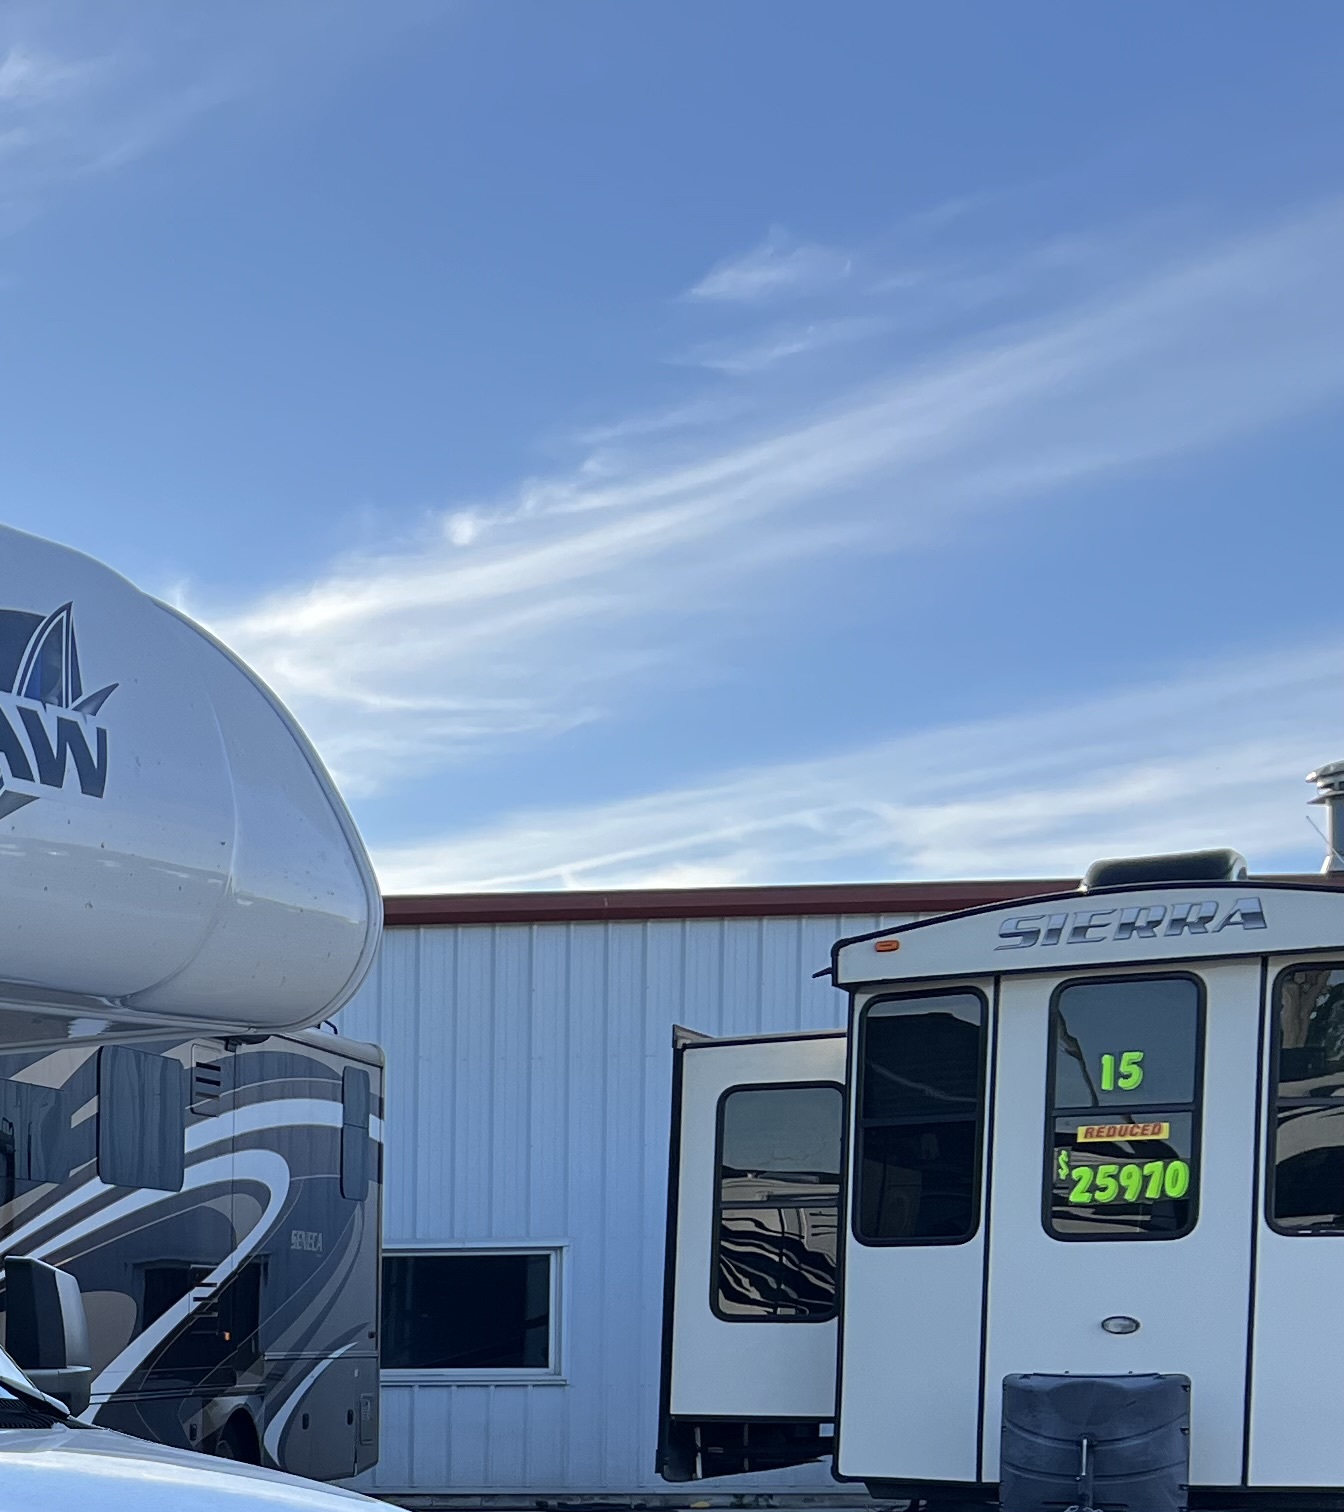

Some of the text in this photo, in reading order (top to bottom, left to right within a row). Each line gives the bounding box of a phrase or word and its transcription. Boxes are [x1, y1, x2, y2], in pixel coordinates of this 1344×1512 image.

[994, 897, 1267, 950] SIERRA
[1100, 1052, 1144, 1090] 15
[1083, 1123, 1162, 1139] REDUCED
